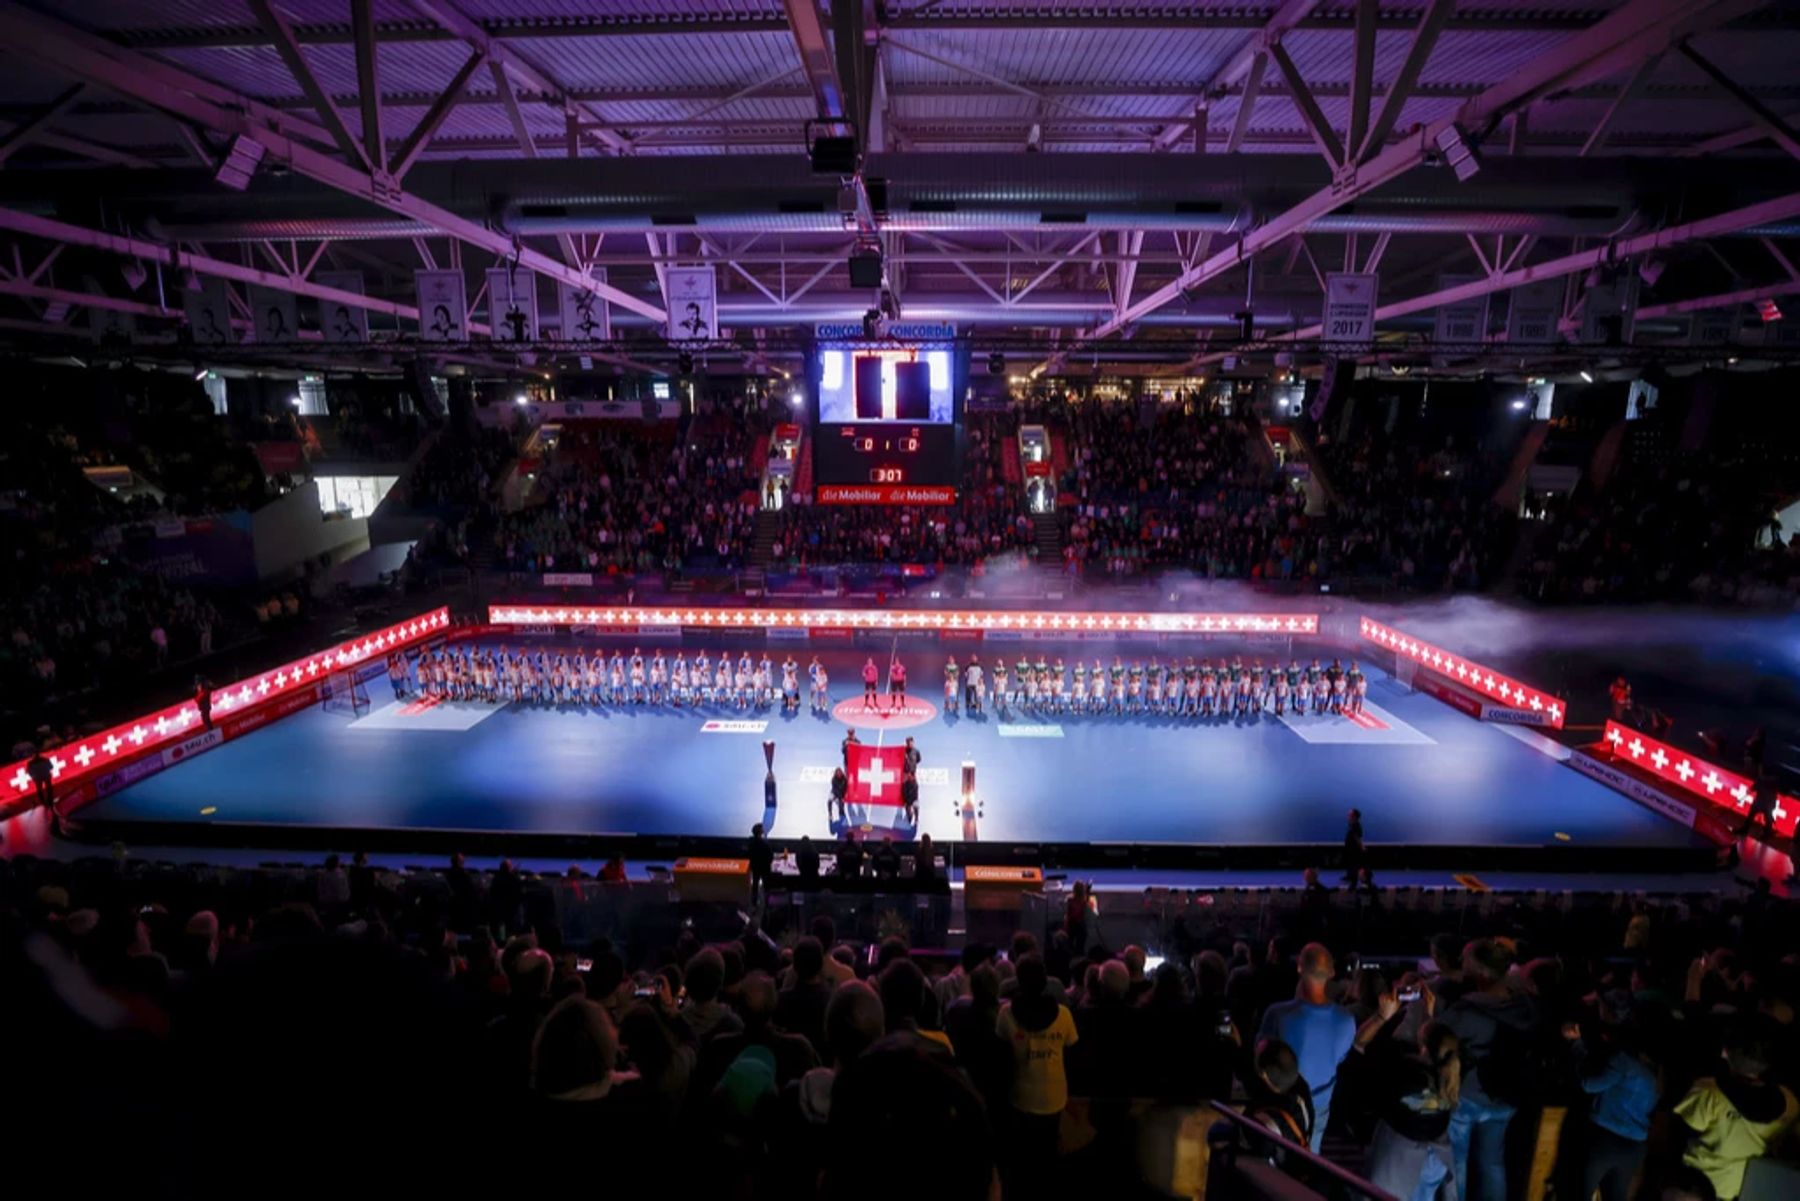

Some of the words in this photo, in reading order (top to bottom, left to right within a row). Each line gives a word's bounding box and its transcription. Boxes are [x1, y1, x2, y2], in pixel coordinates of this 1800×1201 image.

[888, 325, 954, 338] CONCORDIA
[1332, 320, 1363, 335] 2017
[865, 438, 873, 451] 0
[909, 438, 918, 451] 0
[839, 490, 881, 500] Mobiliar
[906, 490, 950, 501] Mobiliar
